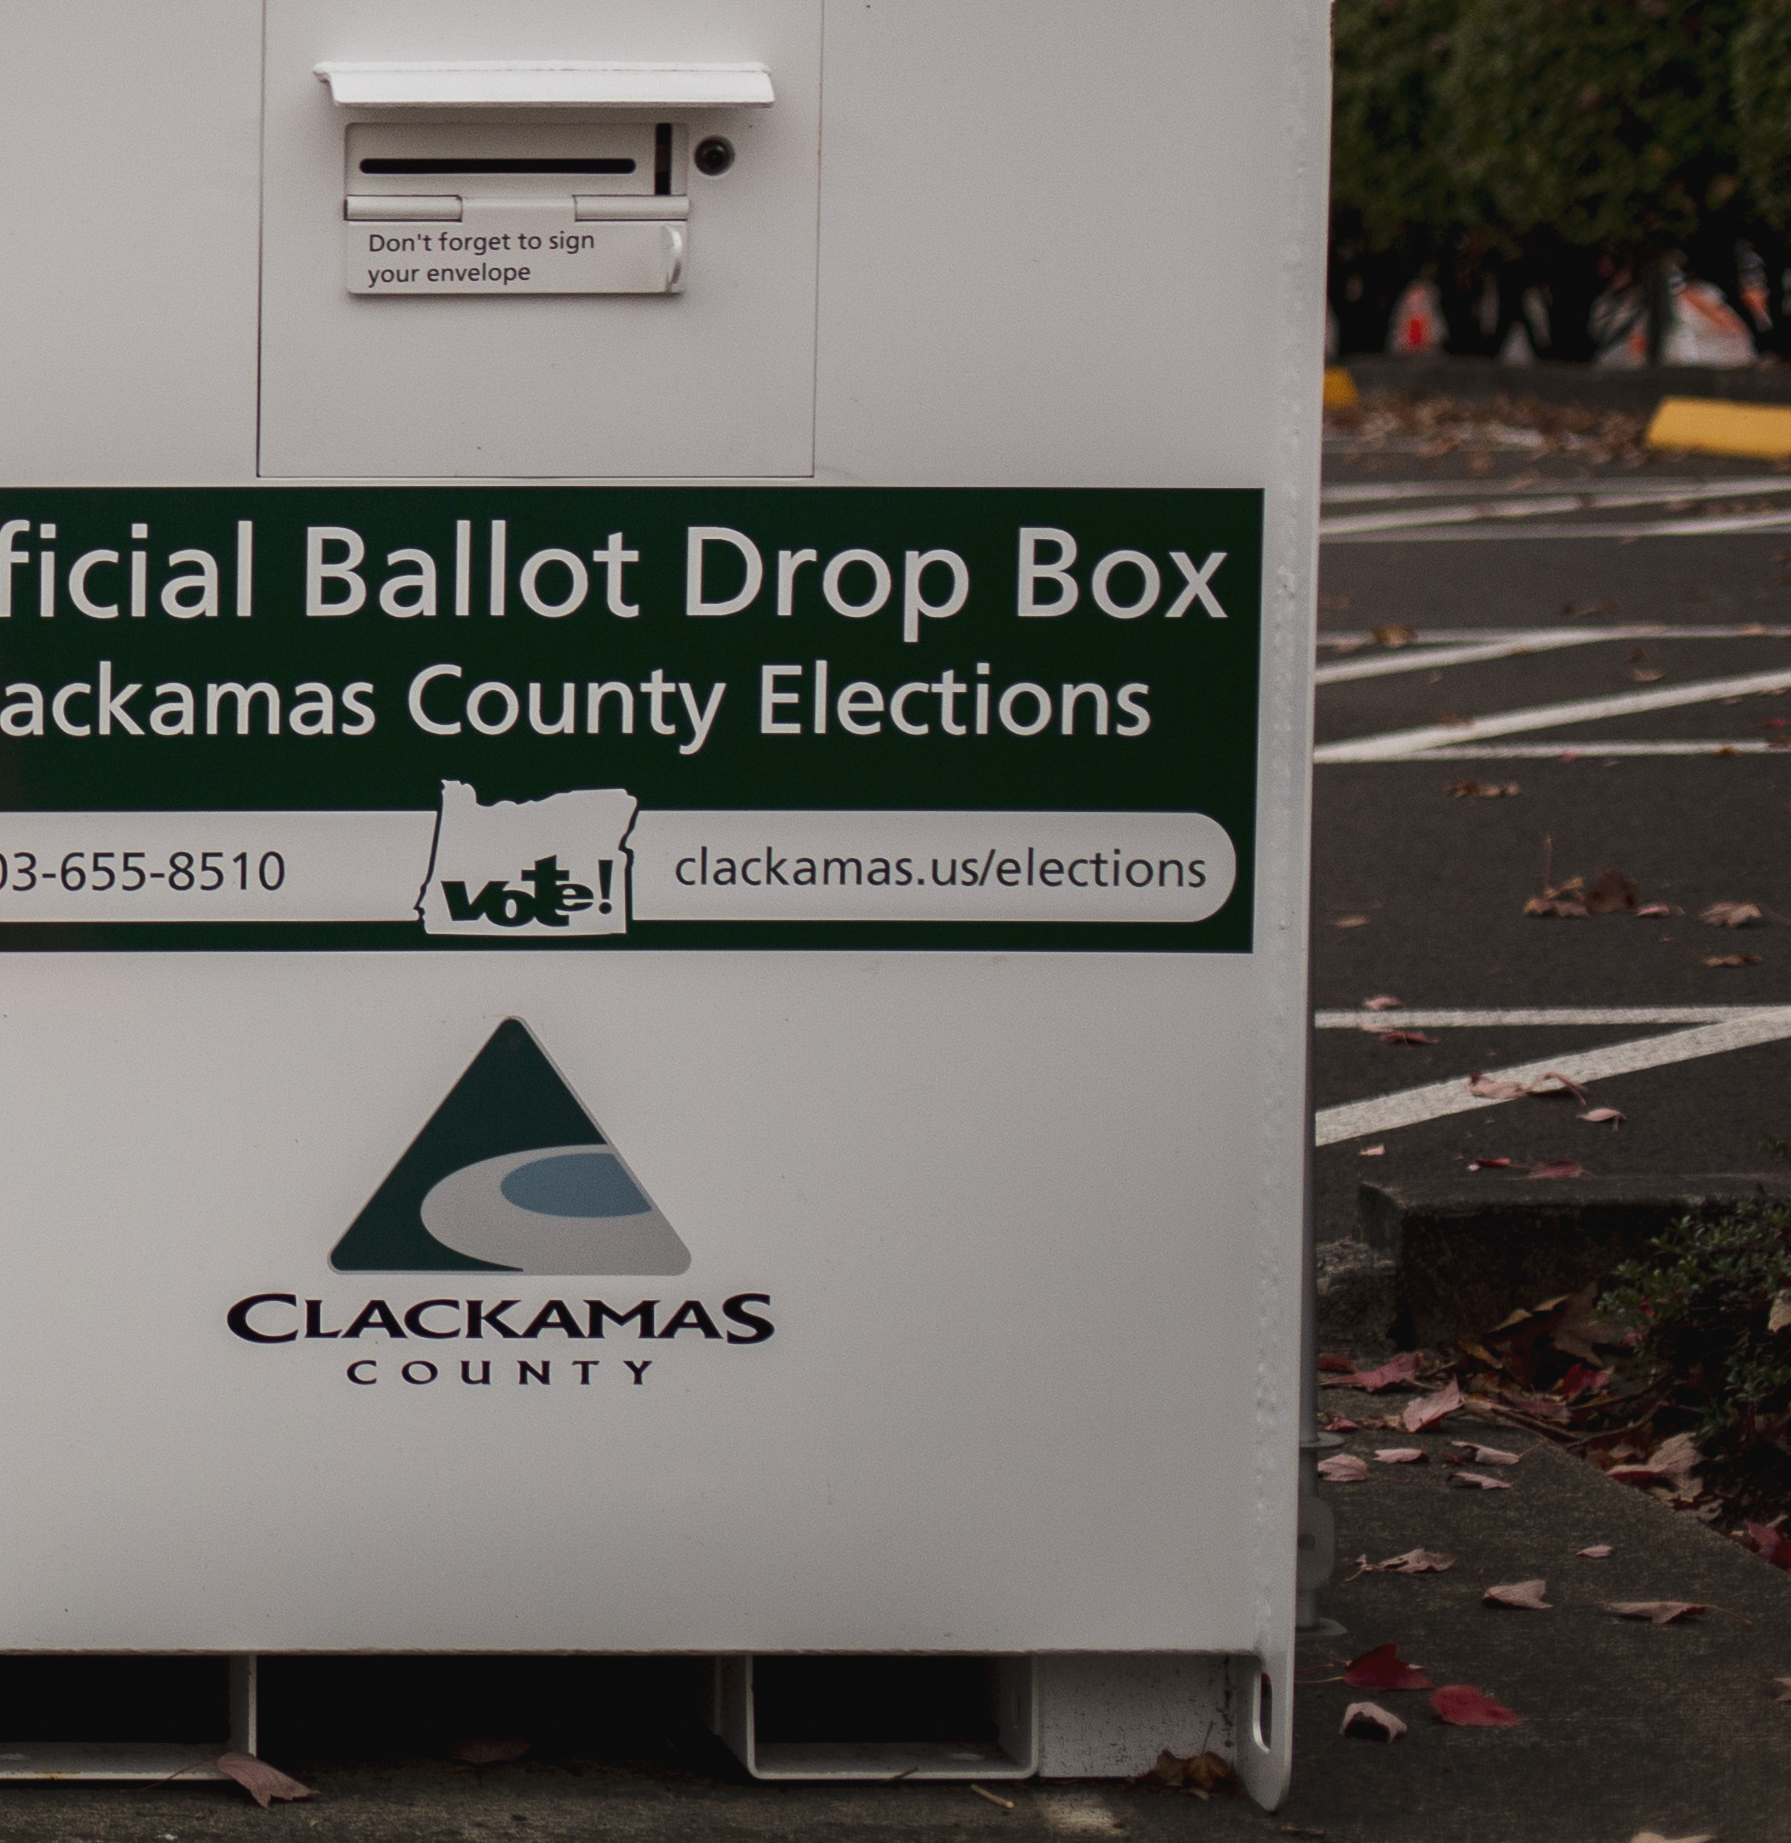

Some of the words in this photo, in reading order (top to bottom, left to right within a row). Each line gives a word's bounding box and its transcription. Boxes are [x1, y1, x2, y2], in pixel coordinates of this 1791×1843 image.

[368, 232, 433, 254] Don't
[438, 231, 511, 256] forget
[517, 232, 543, 251] to
[548, 230, 596, 255] sign
[367, 266, 420, 289] your
[426, 262, 532, 286] envelope
[305, 518, 640, 619] Ballot
[685, 525, 970, 644] Drop
[1016, 526, 1229, 620] Box
[407, 663, 728, 755] County
[759, 659, 1152, 738] Elections
[674, 844, 1207, 890] clackamas.us/elections
[225, 1291, 776, 1346] CLACKAMAS
[345, 1358, 653, 1386] COUNTY
